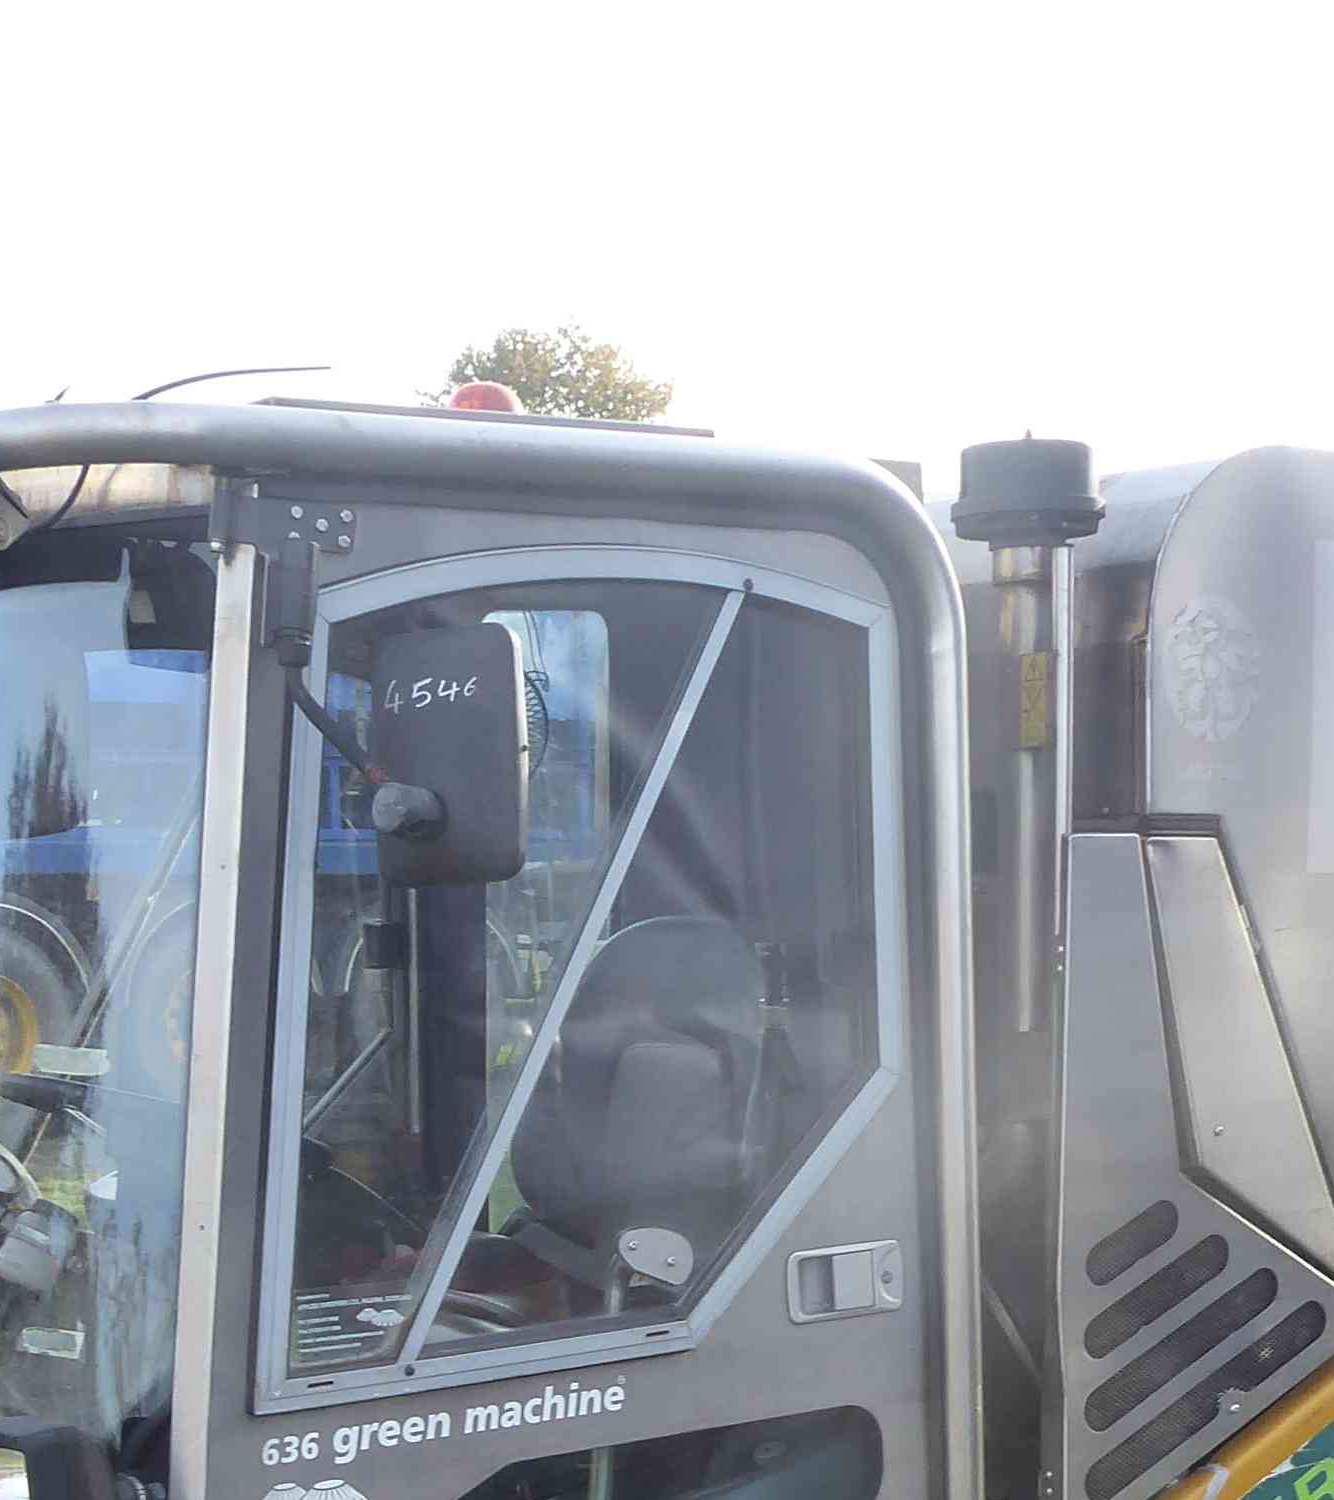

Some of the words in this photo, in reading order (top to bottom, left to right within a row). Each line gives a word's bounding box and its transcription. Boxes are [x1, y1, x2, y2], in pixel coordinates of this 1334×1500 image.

[384, 675, 479, 714] 4546
[262, 1432, 320, 1466] 636
[332, 1410, 452, 1464] green
